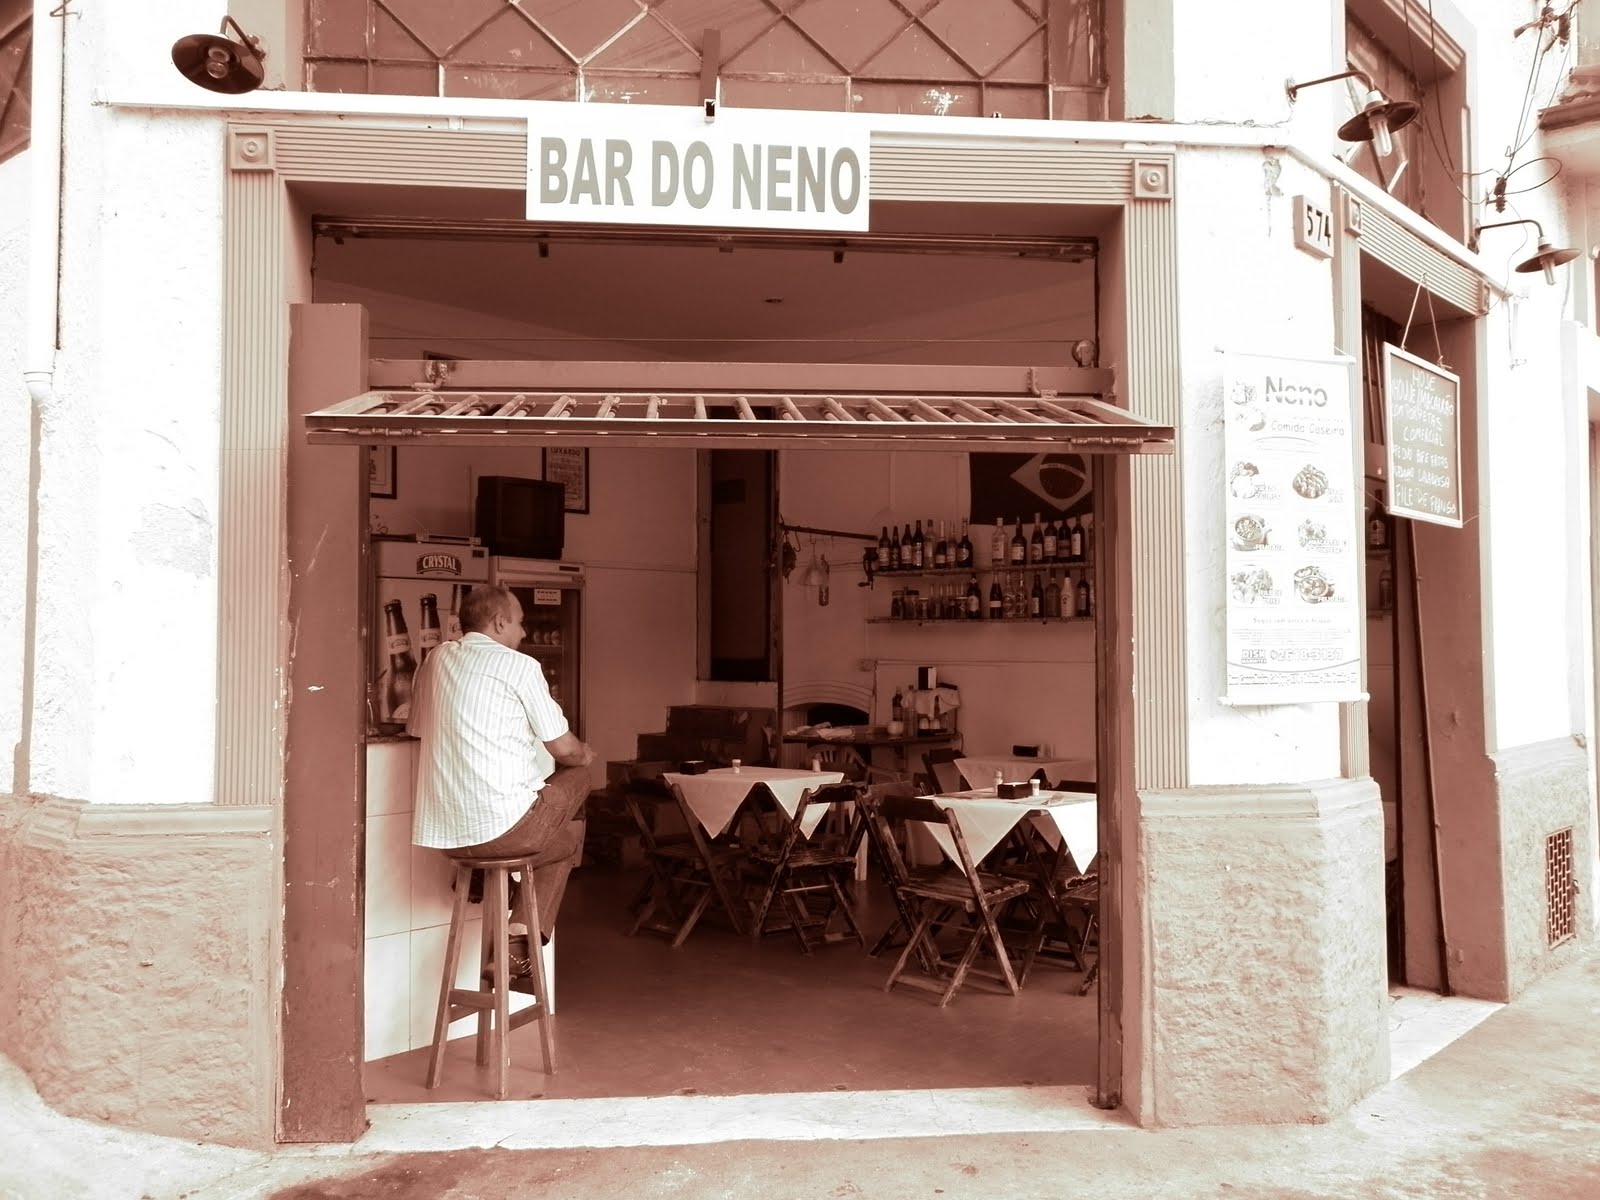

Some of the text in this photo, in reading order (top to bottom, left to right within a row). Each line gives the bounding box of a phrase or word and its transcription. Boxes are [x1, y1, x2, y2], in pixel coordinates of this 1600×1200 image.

[540, 136, 861, 215] BAR DO NENO
[1306, 204, 1331, 247] 574
[1271, 419, 1305, 433] Comida
[1309, 423, 1345, 436] Caseira
[422, 554, 457, 570] CRYSTAL
[1241, 648, 1266, 659] DISK
